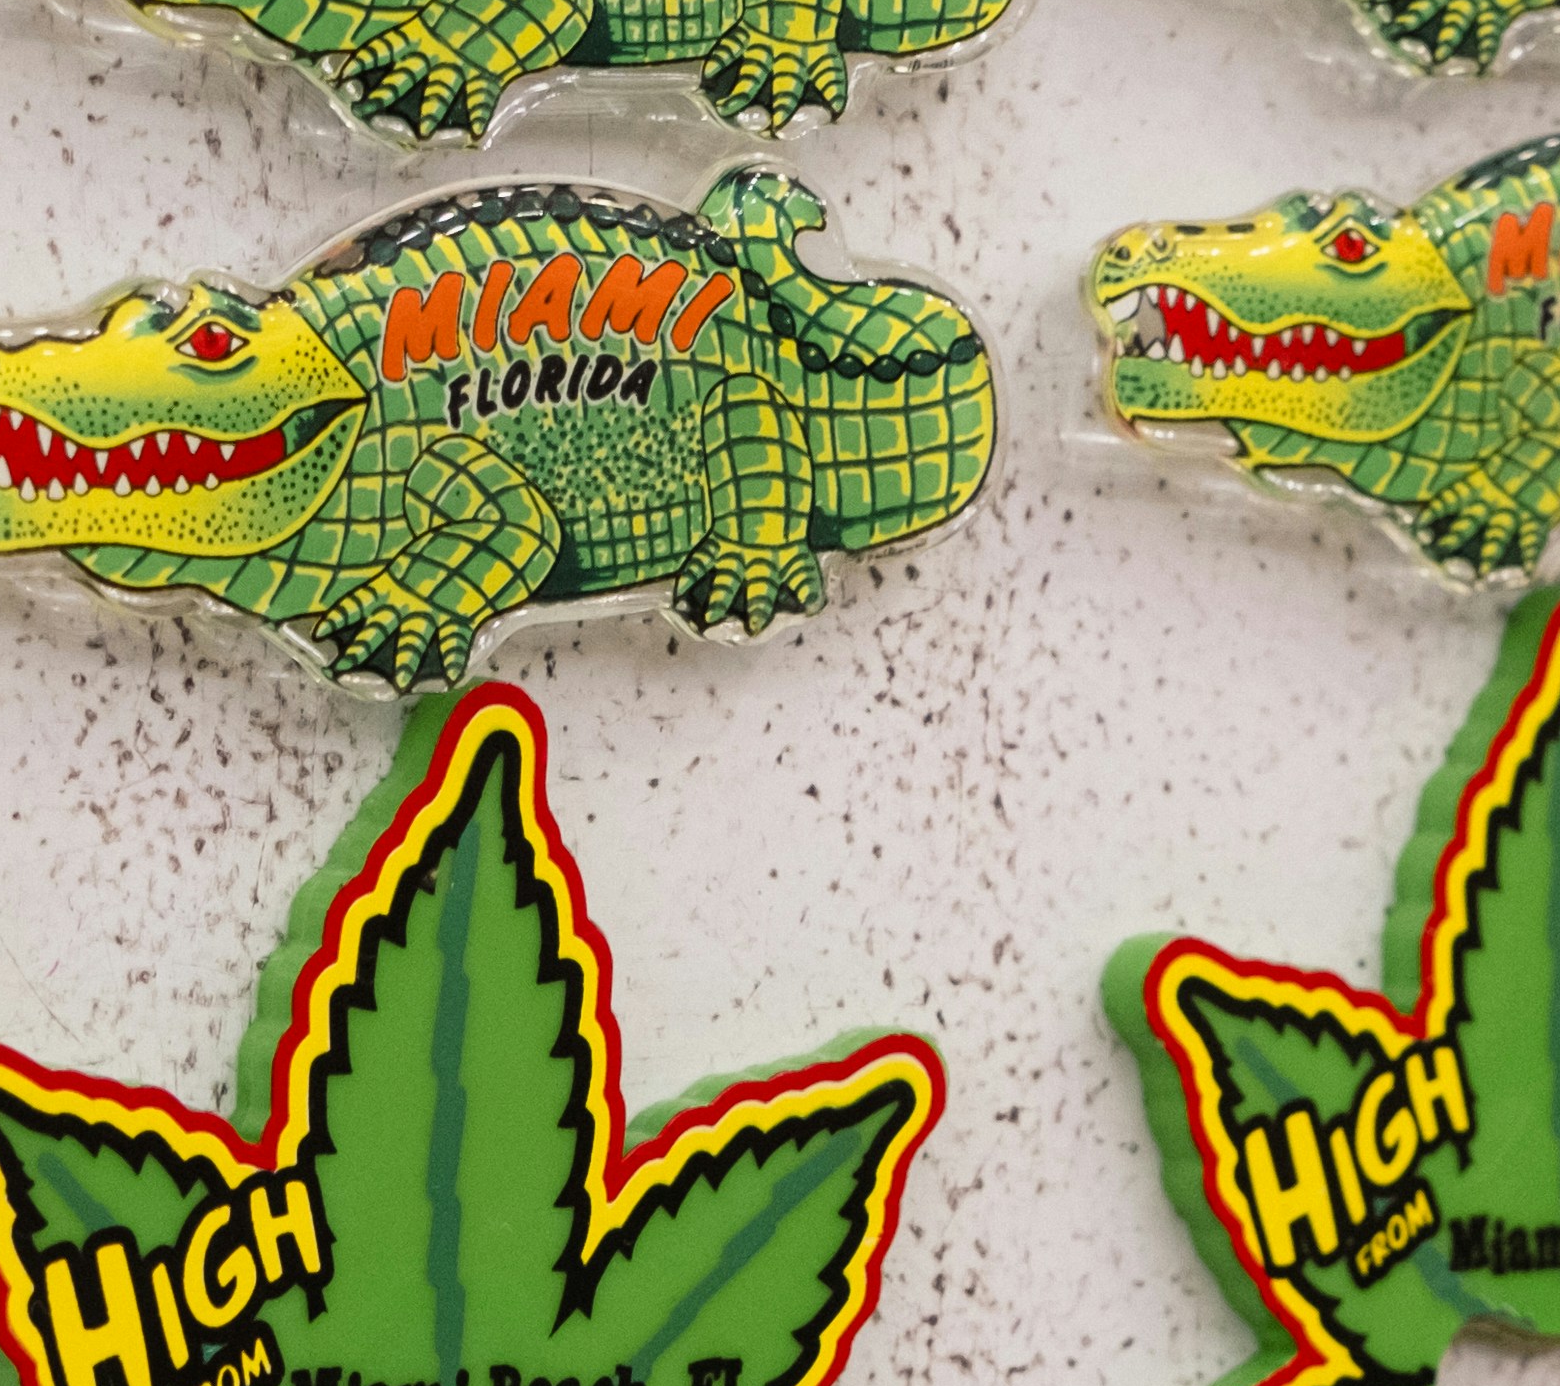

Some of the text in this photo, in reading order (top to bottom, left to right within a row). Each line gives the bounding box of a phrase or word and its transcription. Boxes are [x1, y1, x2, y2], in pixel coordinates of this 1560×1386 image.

[383, 255, 730, 381] MIAMI
[448, 354, 658, 430] FLORIDA
[1245, 1047, 1468, 1267] HIGH
[1354, 1189, 1435, 1277] FROM
